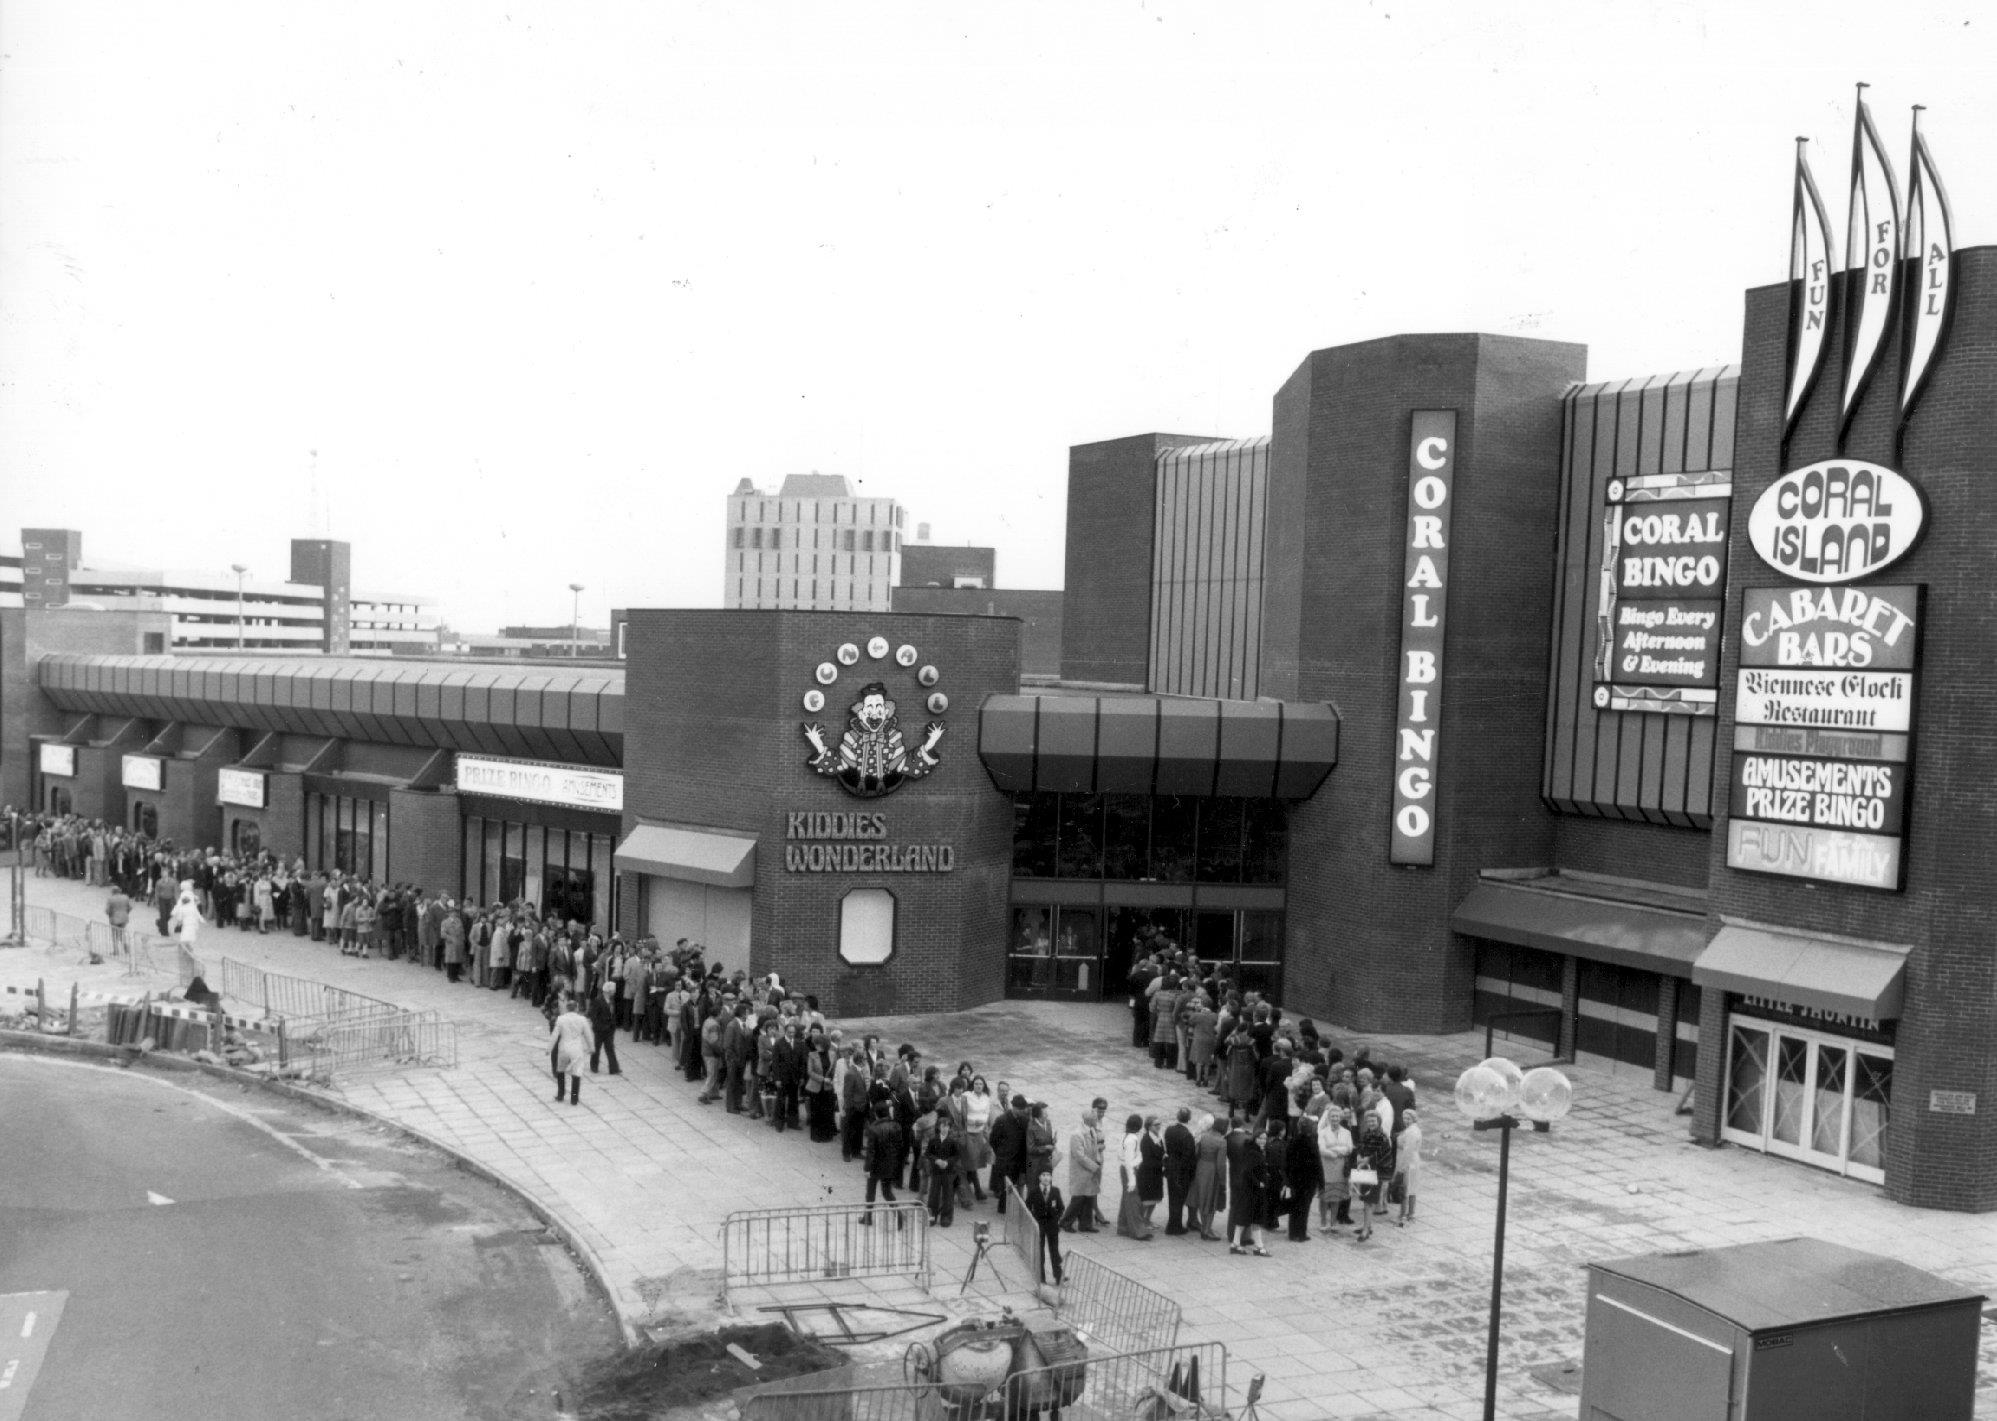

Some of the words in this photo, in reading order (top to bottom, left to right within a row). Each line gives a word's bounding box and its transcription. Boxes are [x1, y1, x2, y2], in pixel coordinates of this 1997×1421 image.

[1805, 259, 1826, 330] FUN
[1870, 221, 1891, 294] FOR
[1925, 243, 1947, 316] ALL
[1777, 466, 1893, 520] CORAL
[1406, 436, 1448, 628] CORAL
[1623, 512, 1724, 545] CORAL
[1772, 522, 1892, 575] ISLAND
[1623, 555, 1720, 587] BINGO
[1619, 606, 1664, 628] Bingo
[1666, 606, 1716, 630] Every
[1742, 586, 1915, 647] CABARET
[1622, 631, 1706, 653] Afternoon
[1777, 631, 1873, 668] BARS
[1622, 654, 1639, 673] &
[1639, 656, 1705, 679] Evening
[1745, 671, 1836, 697] Viennese
[1763, 699, 1878, 728] Restaurant
[1396, 650, 1437, 838] BINGO
[1742, 757, 1892, 798] AMUSEMENTS
[786, 811, 888, 840] KIDDIES
[1746, 787, 1811, 822] PRIZE
[1814, 793, 1885, 829] BINGO
[785, 844, 955, 873] WONDERLAND
[1738, 825, 1813, 870] FUN
[1814, 842, 1891, 884] FAMILY
